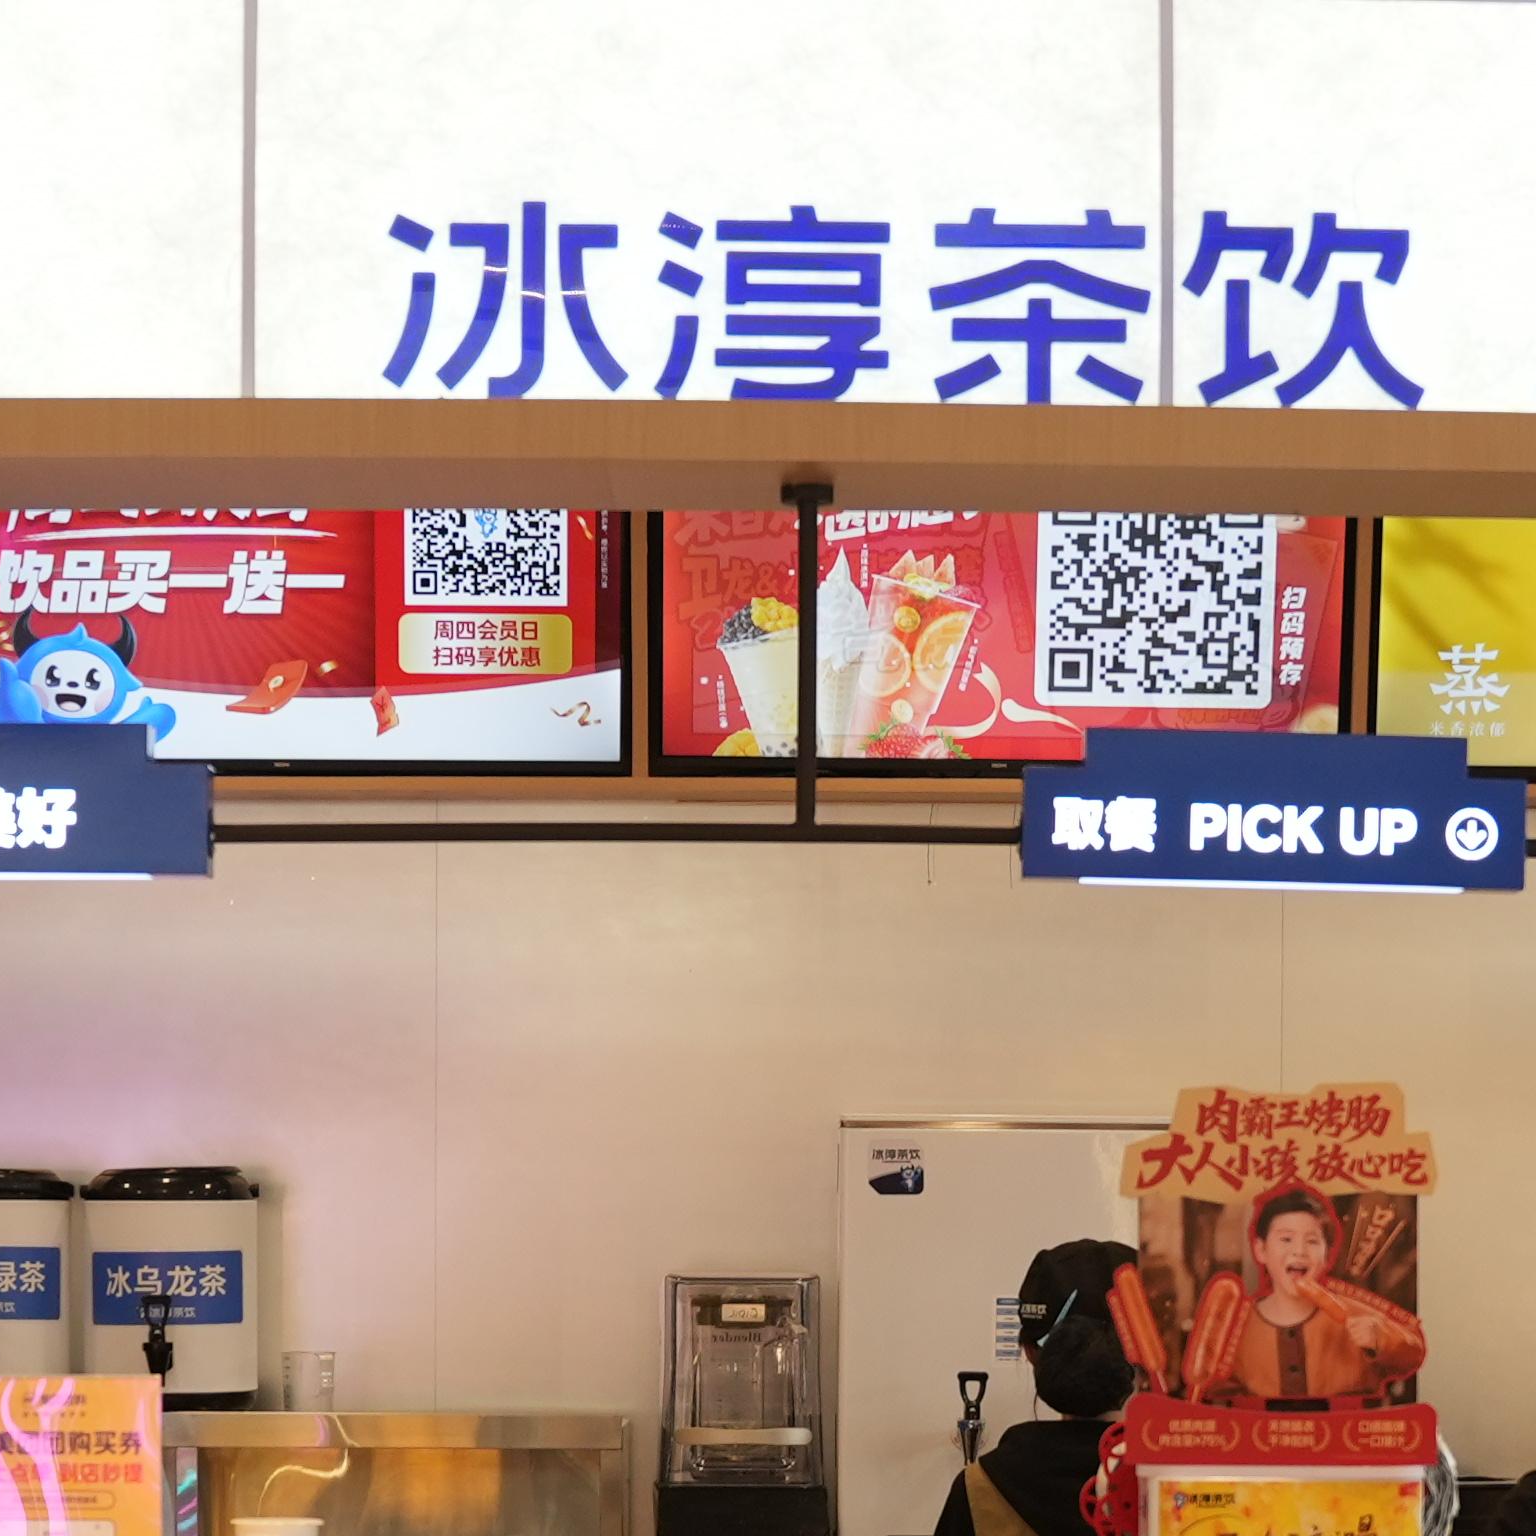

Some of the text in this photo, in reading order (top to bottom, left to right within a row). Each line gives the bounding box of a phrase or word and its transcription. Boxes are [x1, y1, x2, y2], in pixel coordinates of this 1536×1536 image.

[381, 200, 1425, 410] 冰淳茶饮
[431, 645, 542, 669] 扫码享优惠
[432, 618, 540, 643] 周四会员日
[1278, 586, 1306, 687] 扫码预存
[1428, 642, 1511, 716] 蒸
[1428, 721, 1507, 738] 米香浓郁
[1050, 795, 1419, 857] 取餐 PICK UP
[1195, 1089, 1392, 1143] 肉霸王烤肠
[105, 1264, 227, 1299] 冰乌龙茶
